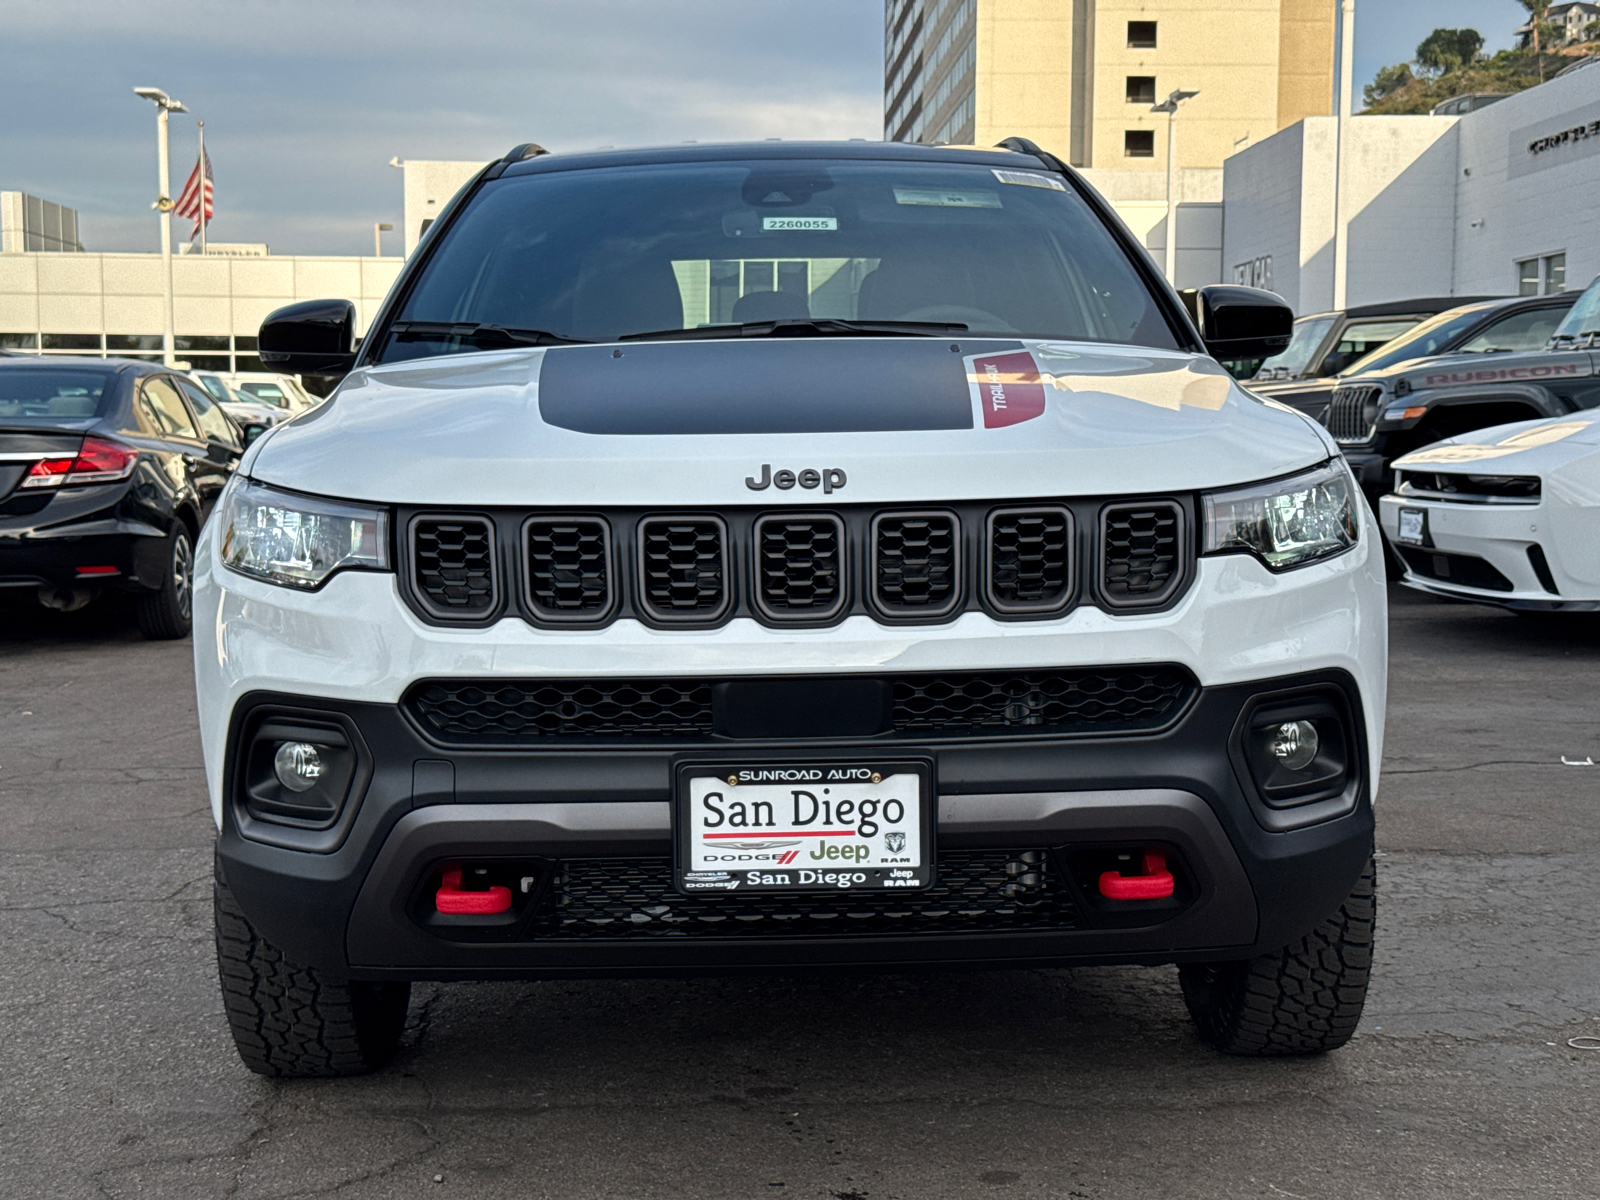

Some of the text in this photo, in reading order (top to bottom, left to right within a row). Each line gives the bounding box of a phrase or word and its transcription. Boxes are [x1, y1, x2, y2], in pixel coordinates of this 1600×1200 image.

[769, 220, 829, 229] 2260055
[1425, 364, 1577, 386] RUBICON
[745, 464, 847, 495] Jeep
[739, 768, 872, 781] SUNROAD AUTO
[703, 788, 905, 838] San Diego
[703, 853, 786, 862] DODGE
[810, 840, 870, 864] Jeep
[746, 869, 866, 888] San Diego
[889, 868, 914, 879] Jeep
[883, 879, 920, 887] RAM
